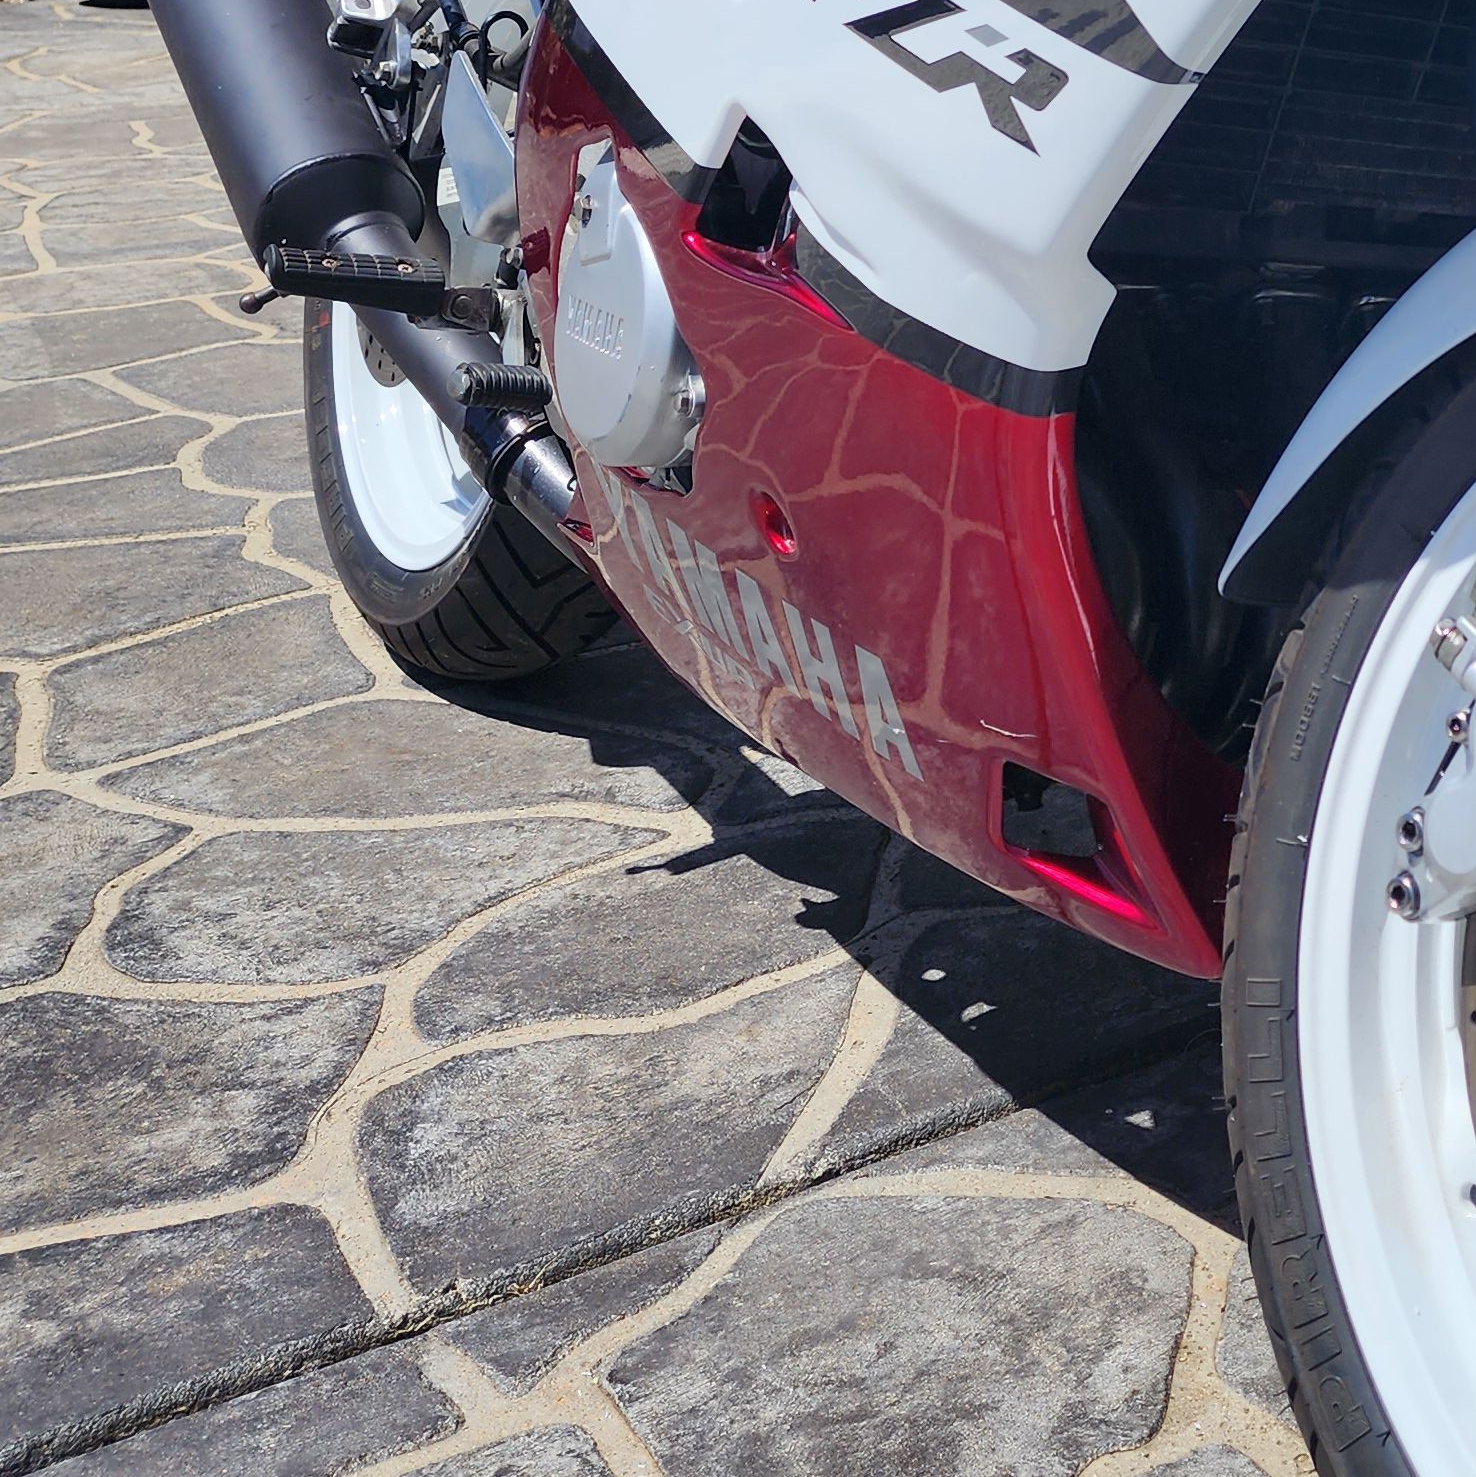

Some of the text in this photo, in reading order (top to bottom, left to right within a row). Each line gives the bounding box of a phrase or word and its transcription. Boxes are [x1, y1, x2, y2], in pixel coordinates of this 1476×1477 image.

[566, 294, 624, 360] YAMAHA
[598, 465, 925, 782] YAMAHA
[1245, 977, 1373, 1453] PIRELLI
